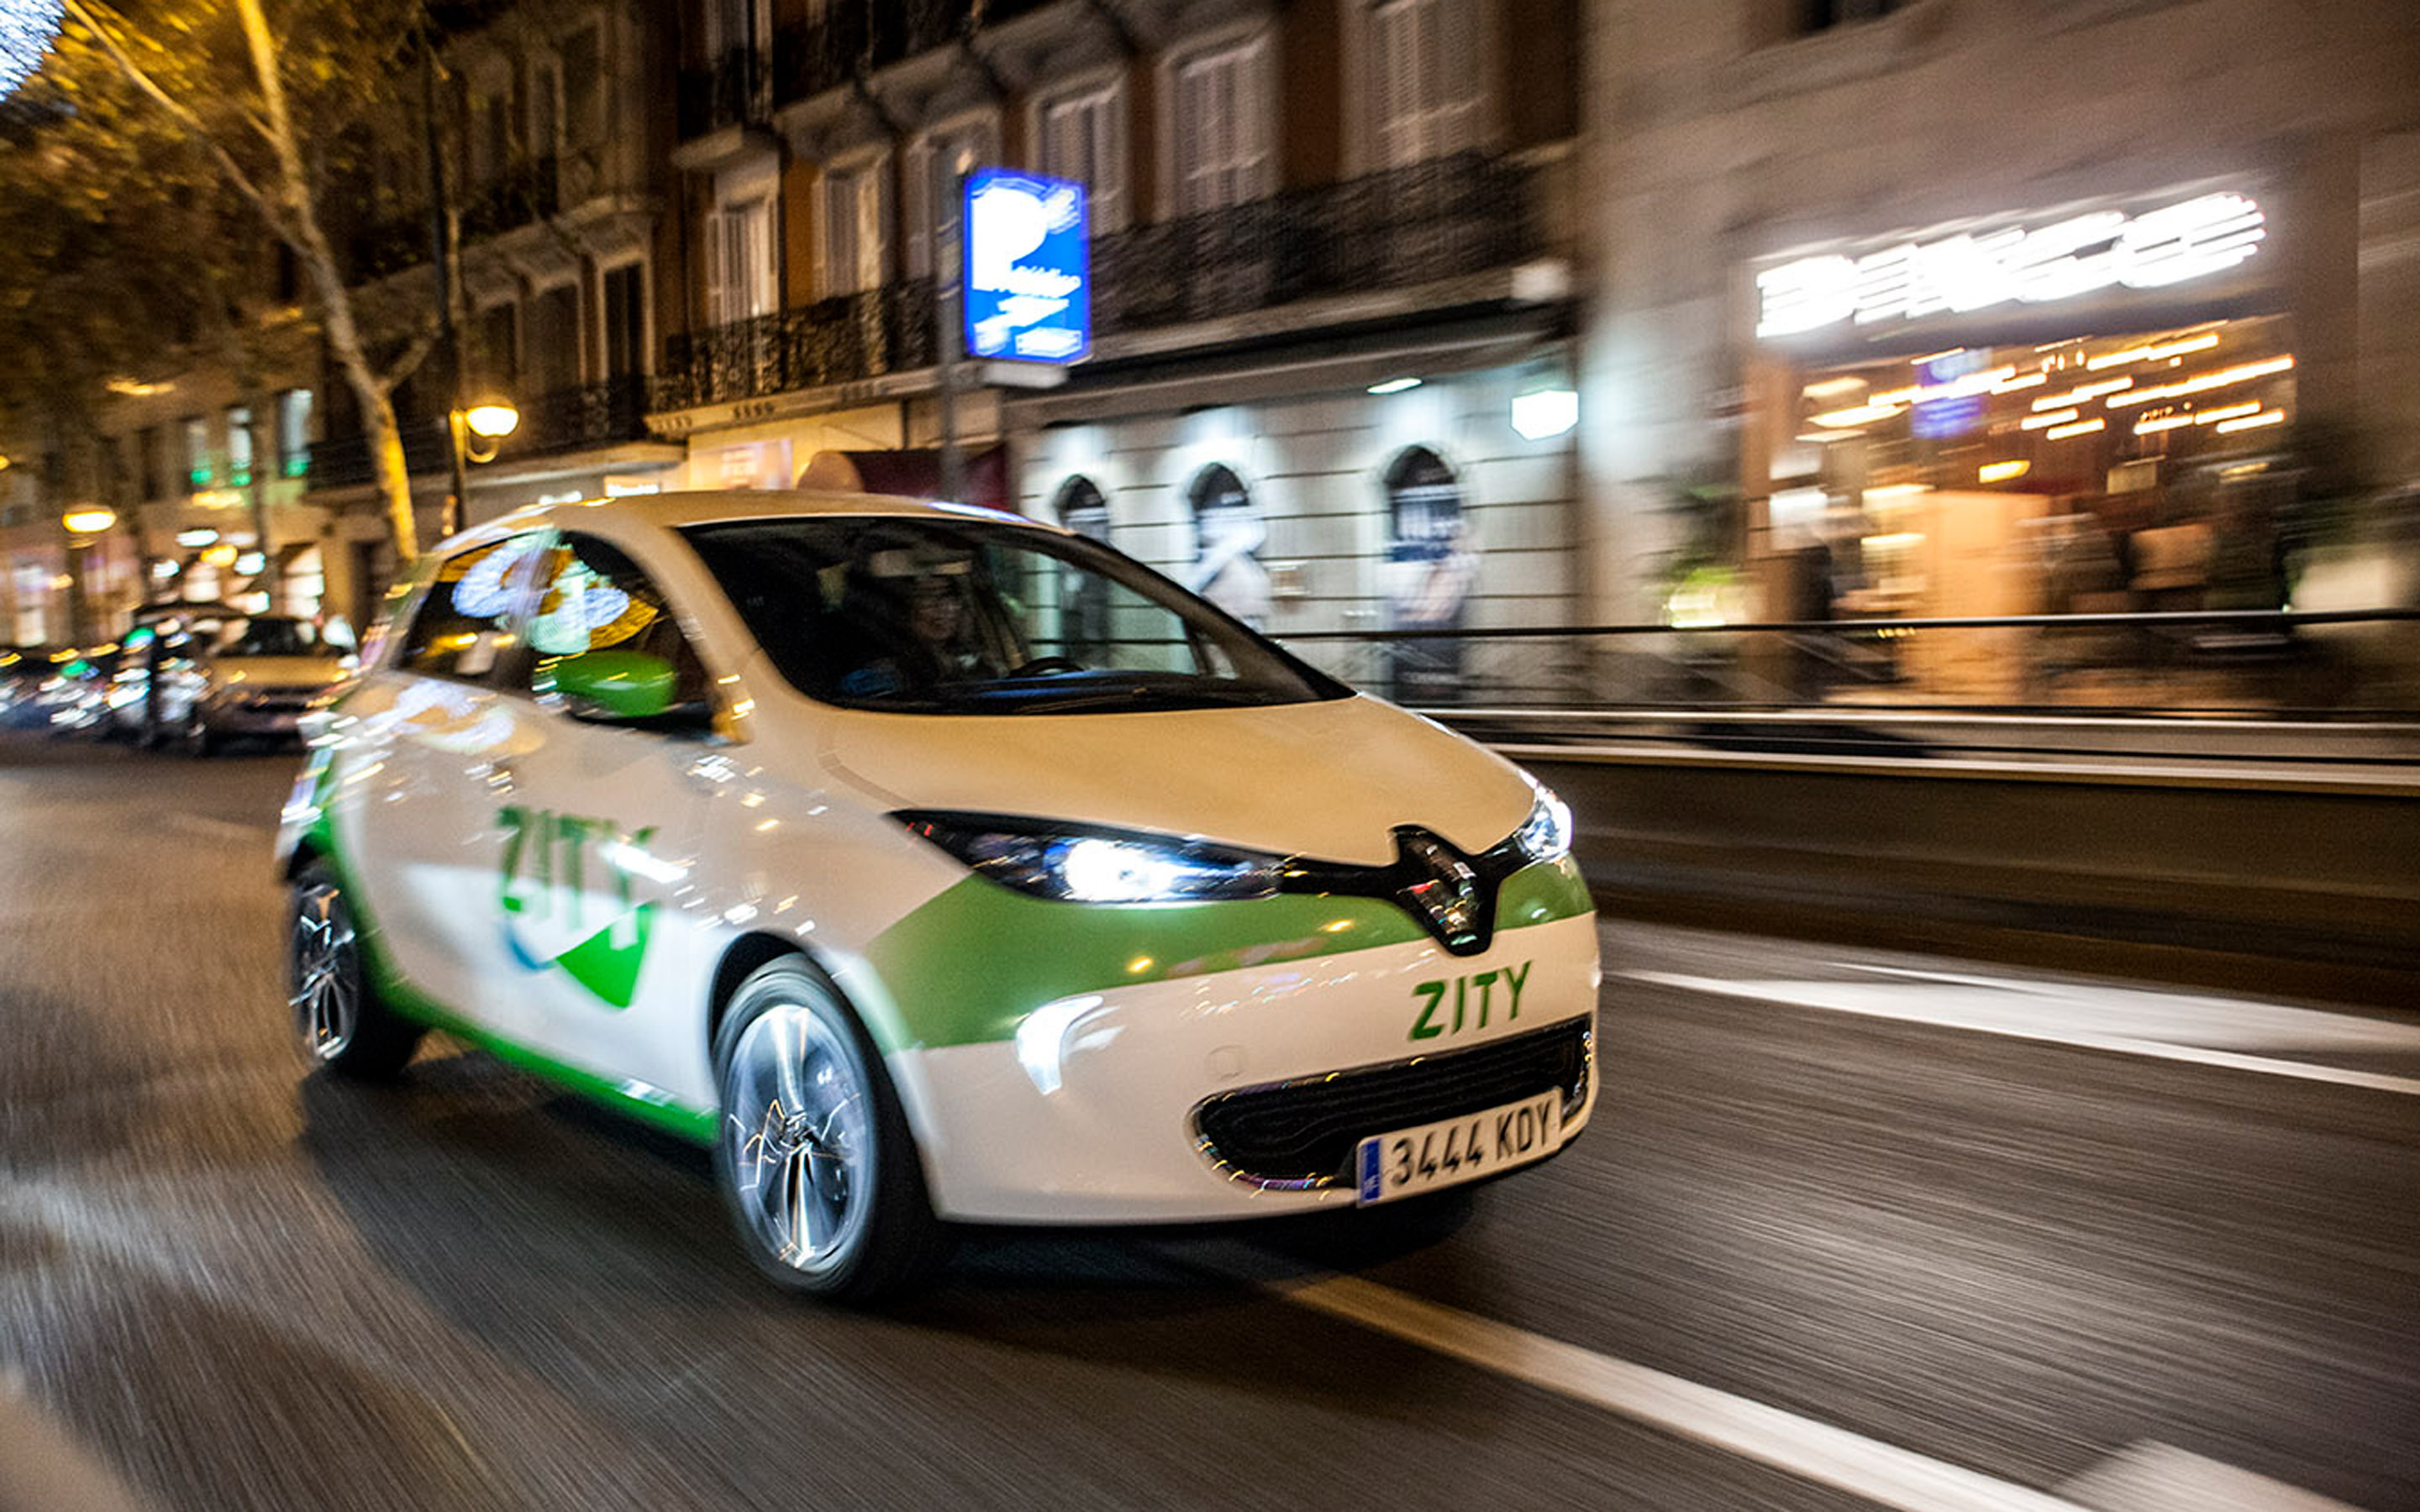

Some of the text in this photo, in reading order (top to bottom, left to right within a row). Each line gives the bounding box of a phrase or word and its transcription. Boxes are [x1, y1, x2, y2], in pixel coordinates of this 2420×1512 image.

[497, 806, 659, 946] ZITY
[1408, 959, 1533, 1041] ZITY
[1390, 1098, 1553, 1187] 3444 KDY
